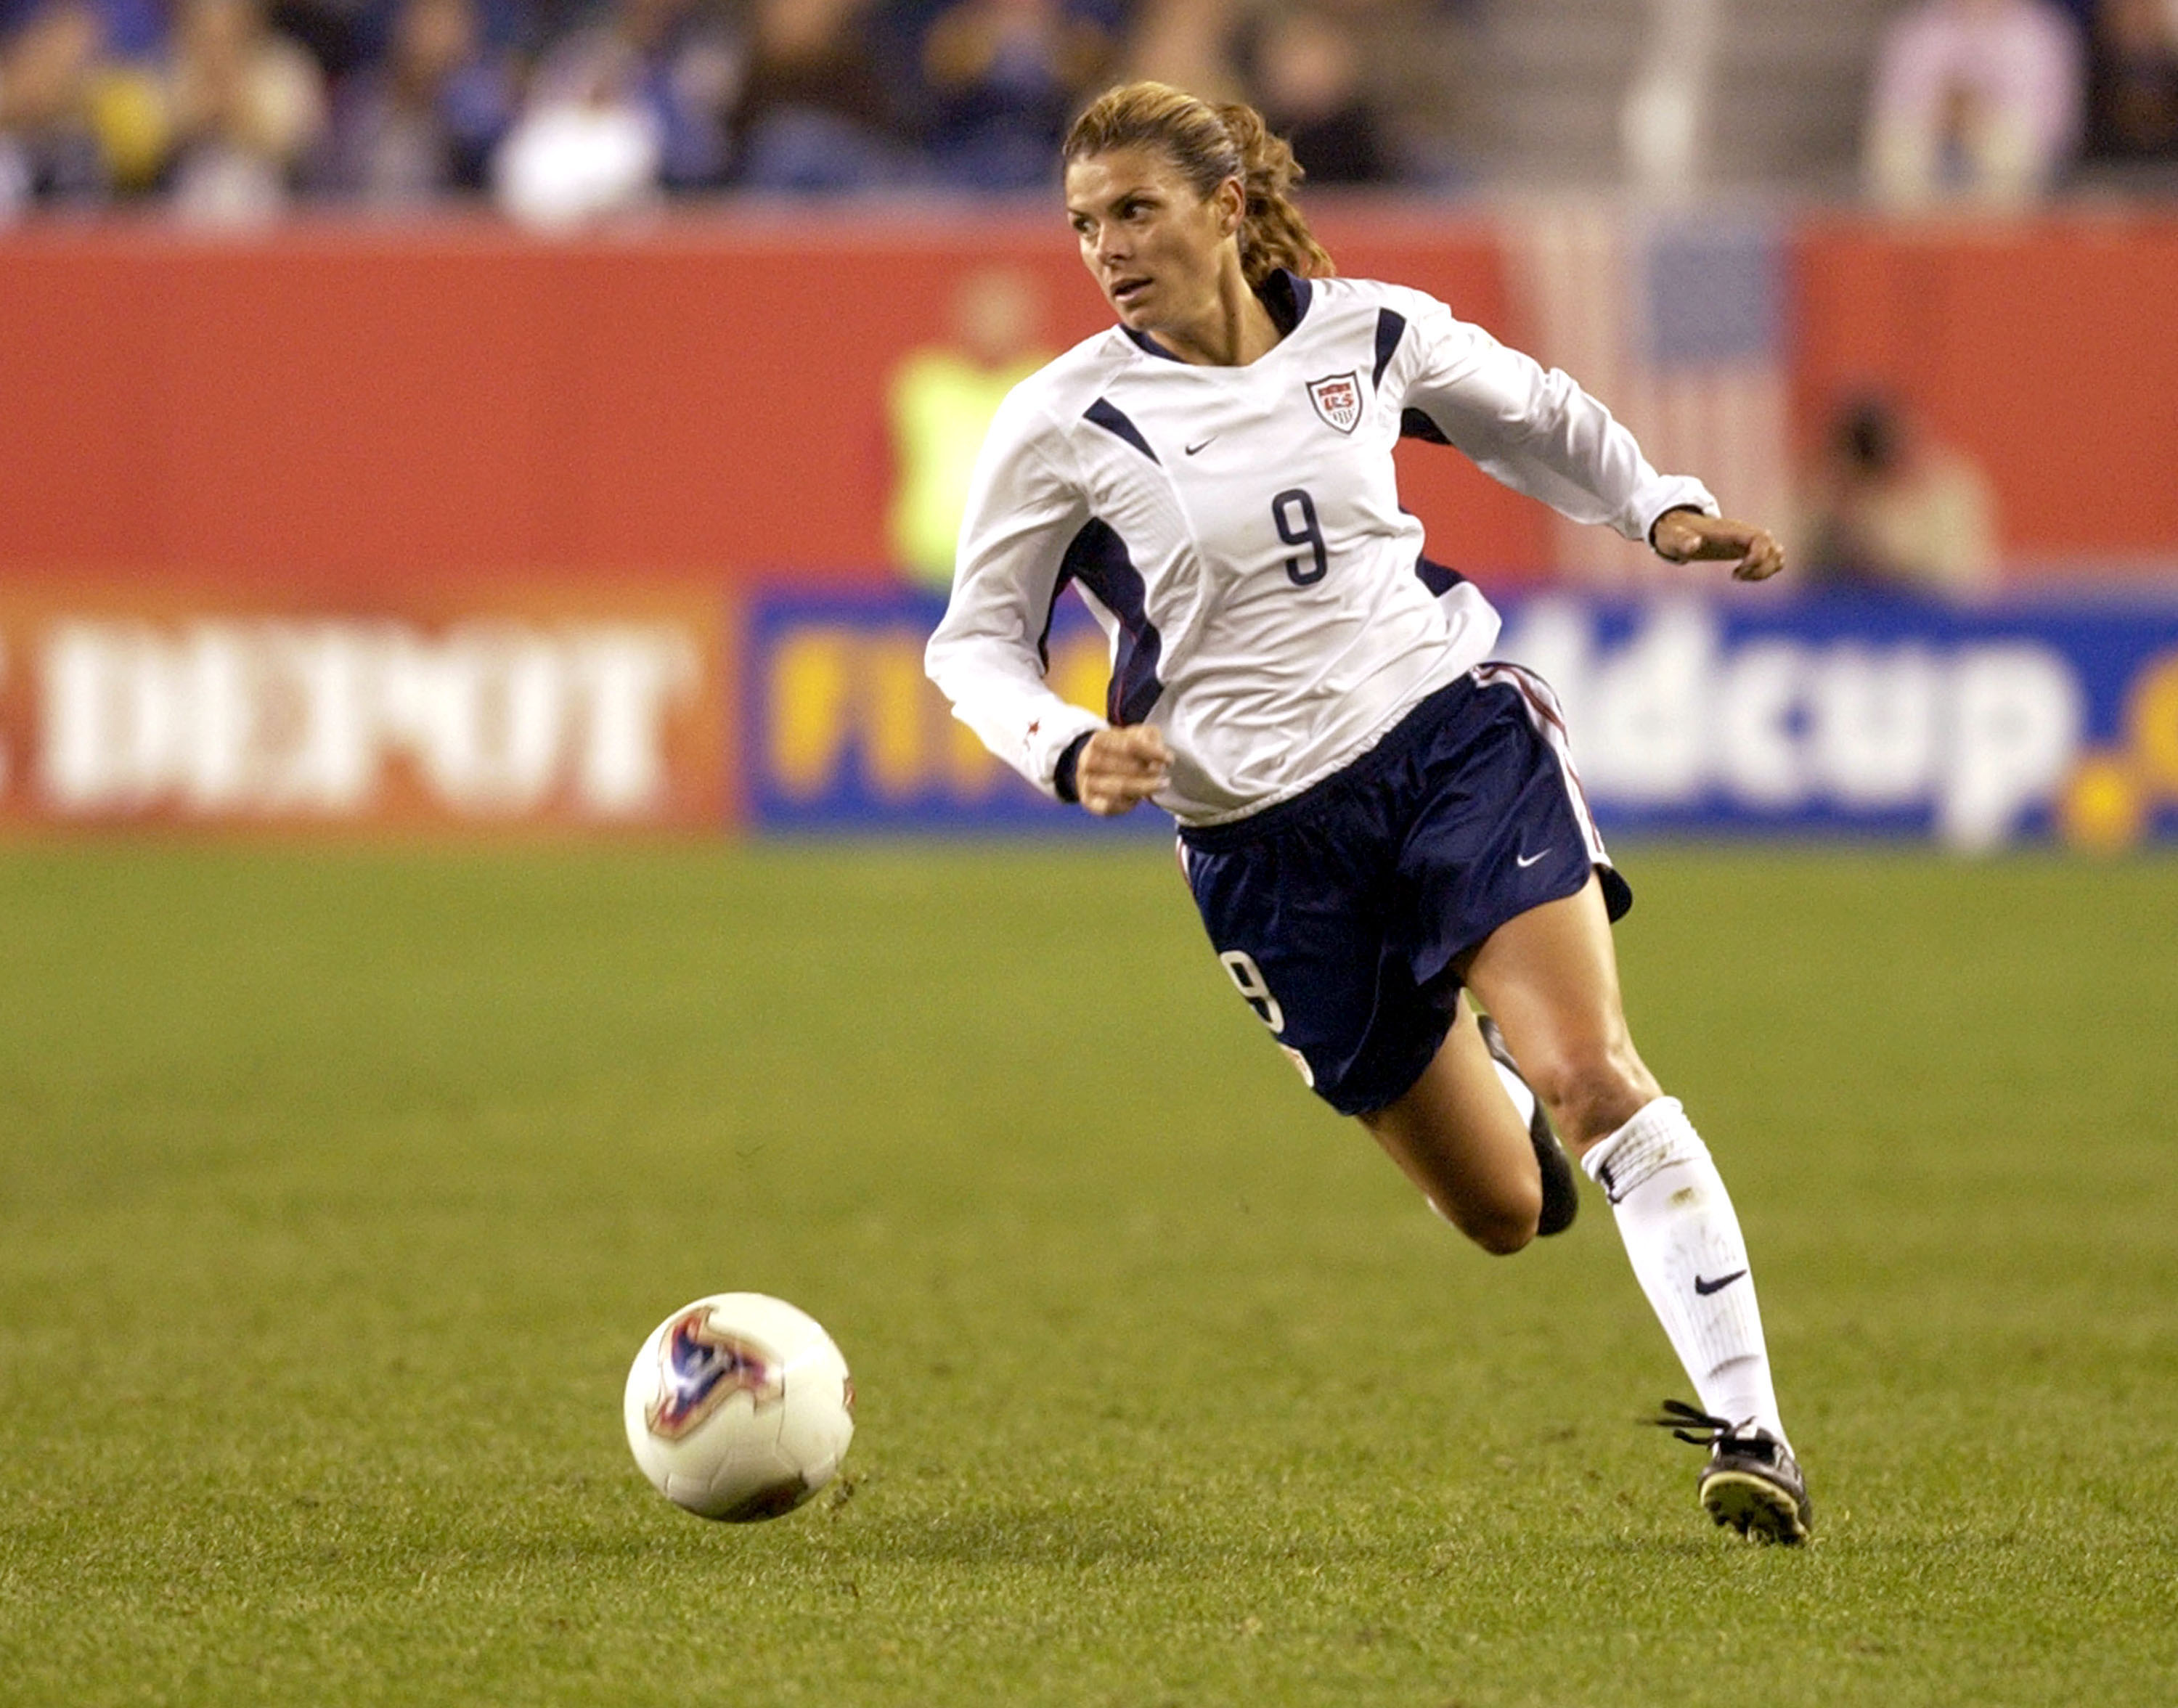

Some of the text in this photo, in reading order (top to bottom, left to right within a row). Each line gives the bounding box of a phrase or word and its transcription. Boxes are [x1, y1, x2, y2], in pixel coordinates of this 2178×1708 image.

[1272, 488, 1328, 587] 9
[45, 618, 698, 814] DEPOT
[1219, 950, 1284, 1034] 9
